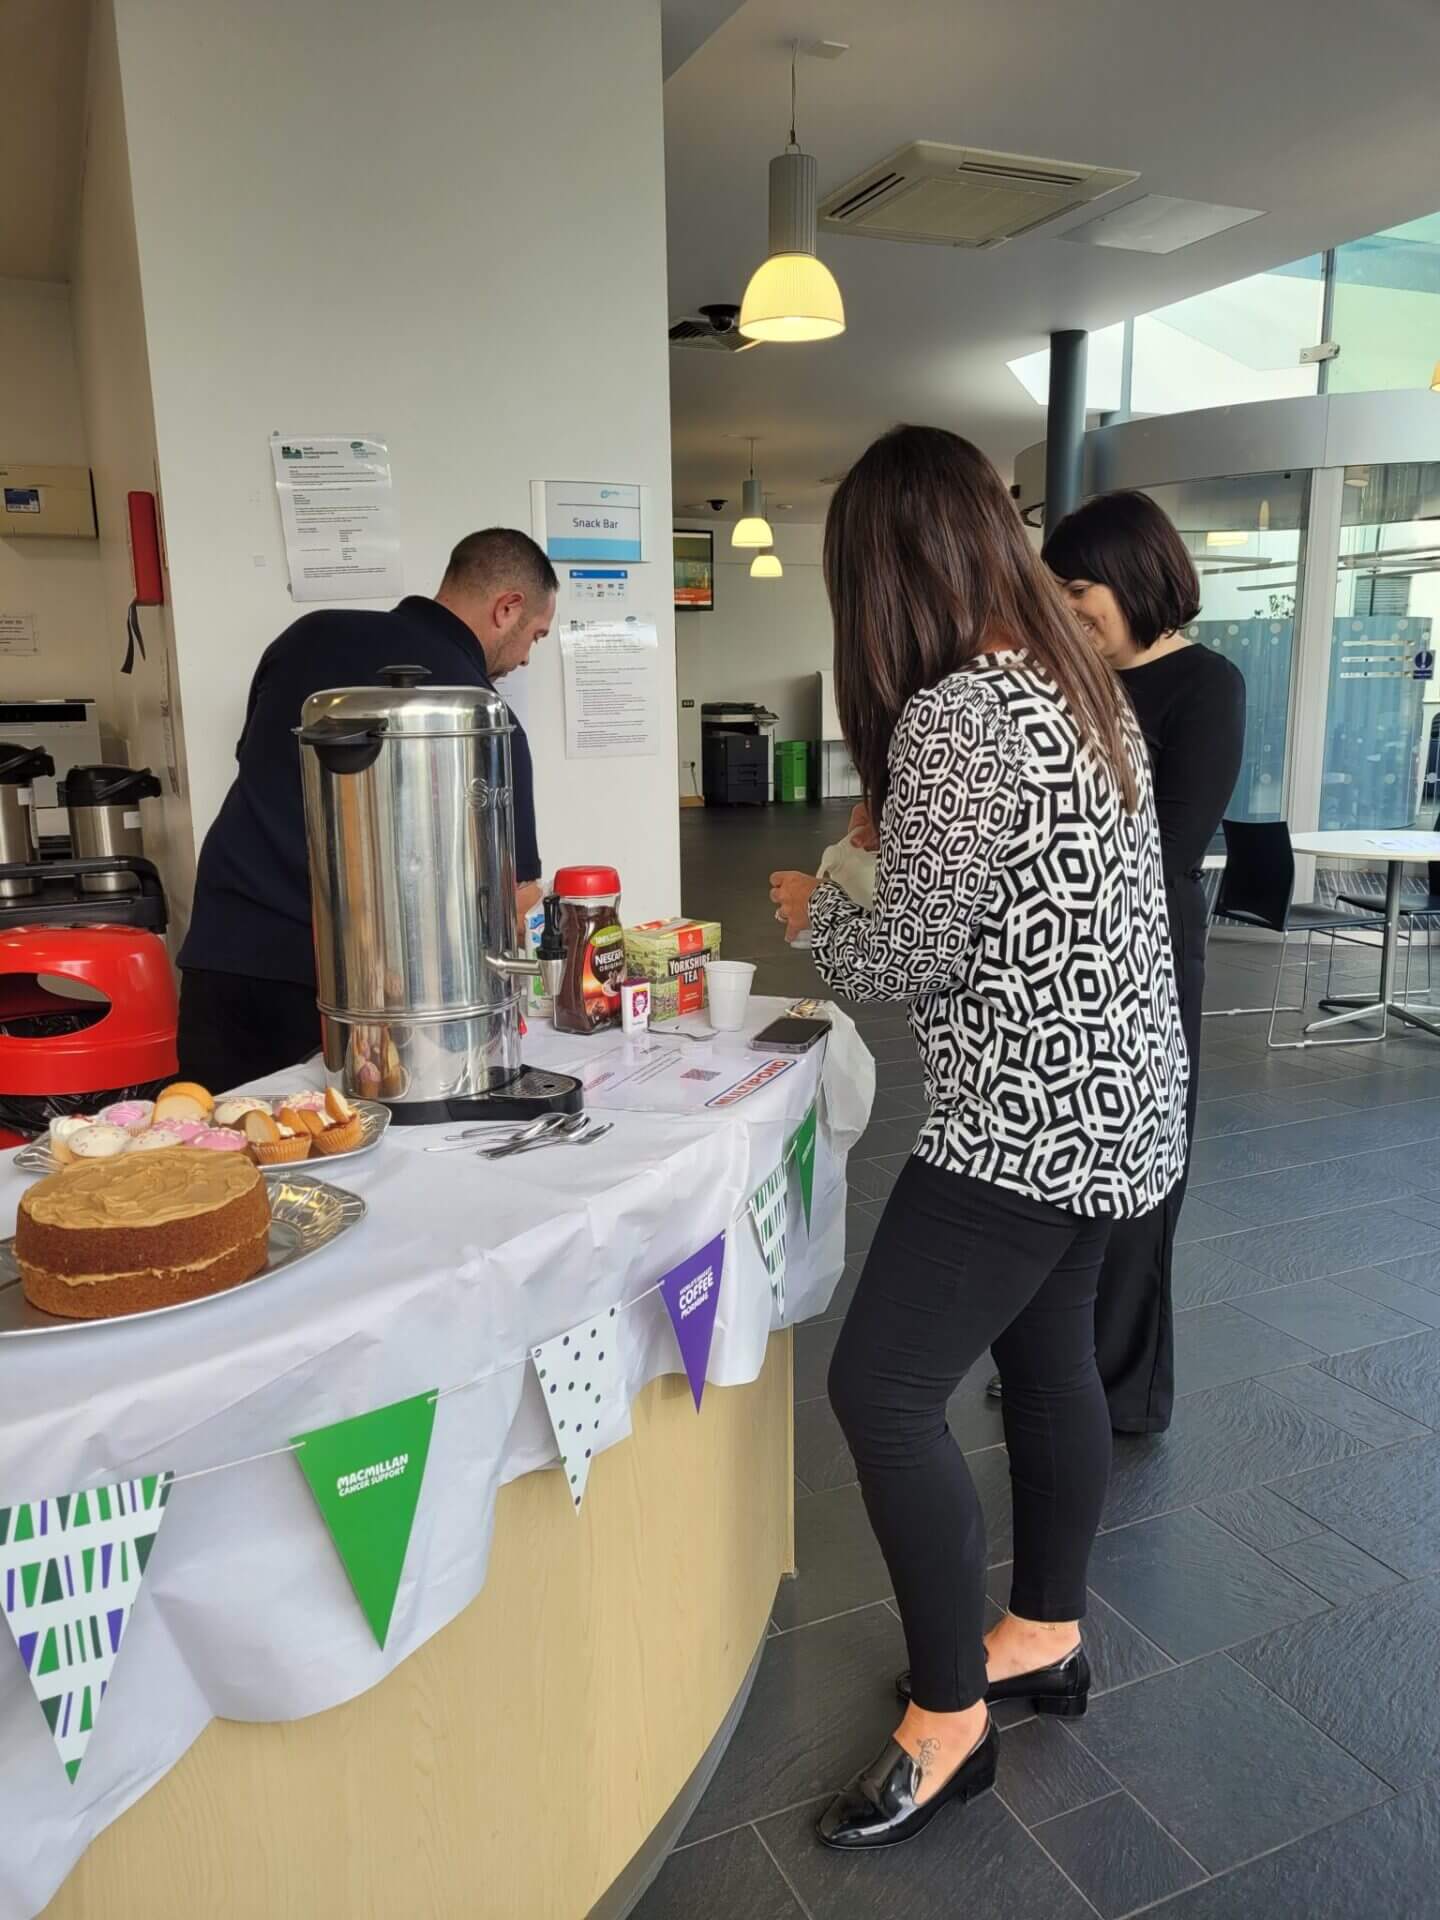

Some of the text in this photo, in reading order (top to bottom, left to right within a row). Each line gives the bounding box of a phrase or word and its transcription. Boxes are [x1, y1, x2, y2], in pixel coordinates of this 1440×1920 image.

[573, 517, 619, 529] Snack Bar
[468, 777, 512, 809] Swa
[595, 948, 624, 966] NESCAF
[669, 953, 710, 975] YORKSHIRE
[684, 969, 698, 984] TEA
[714, 1061, 789, 1106] MULTIPOND
[679, 1272, 714, 1310] COFFEE
[337, 1453, 408, 1490] MACMILLAN
[339, 1465, 406, 1497] CANCER SUPPORT
